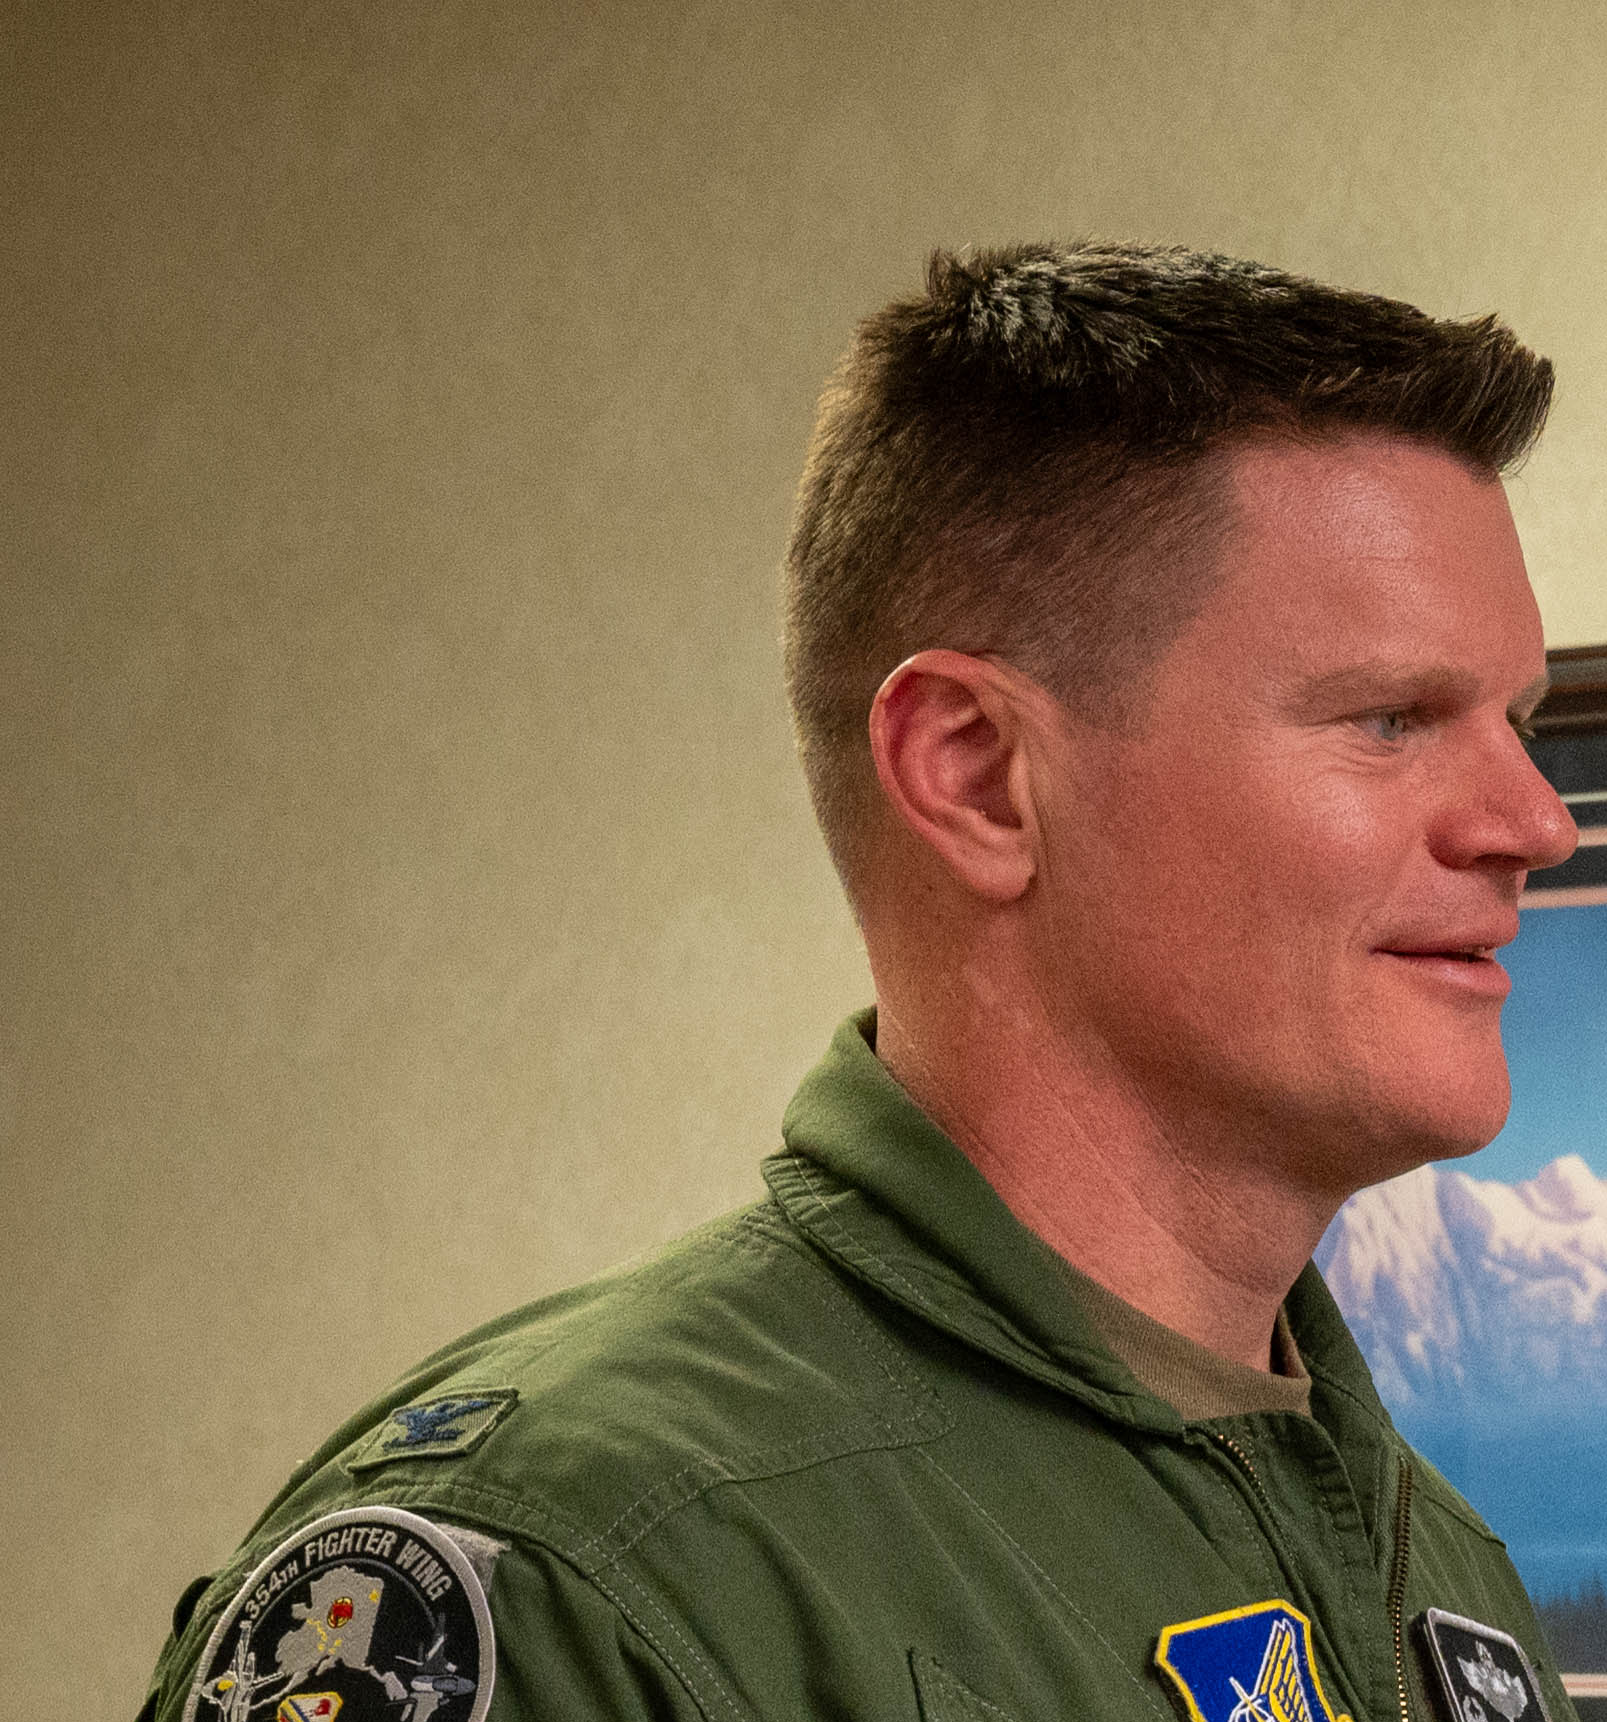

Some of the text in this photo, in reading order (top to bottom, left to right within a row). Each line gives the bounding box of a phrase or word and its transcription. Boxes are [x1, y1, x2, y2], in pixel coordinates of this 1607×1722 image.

[245, 1527, 453, 1618] 354TH FIGHTER WING
